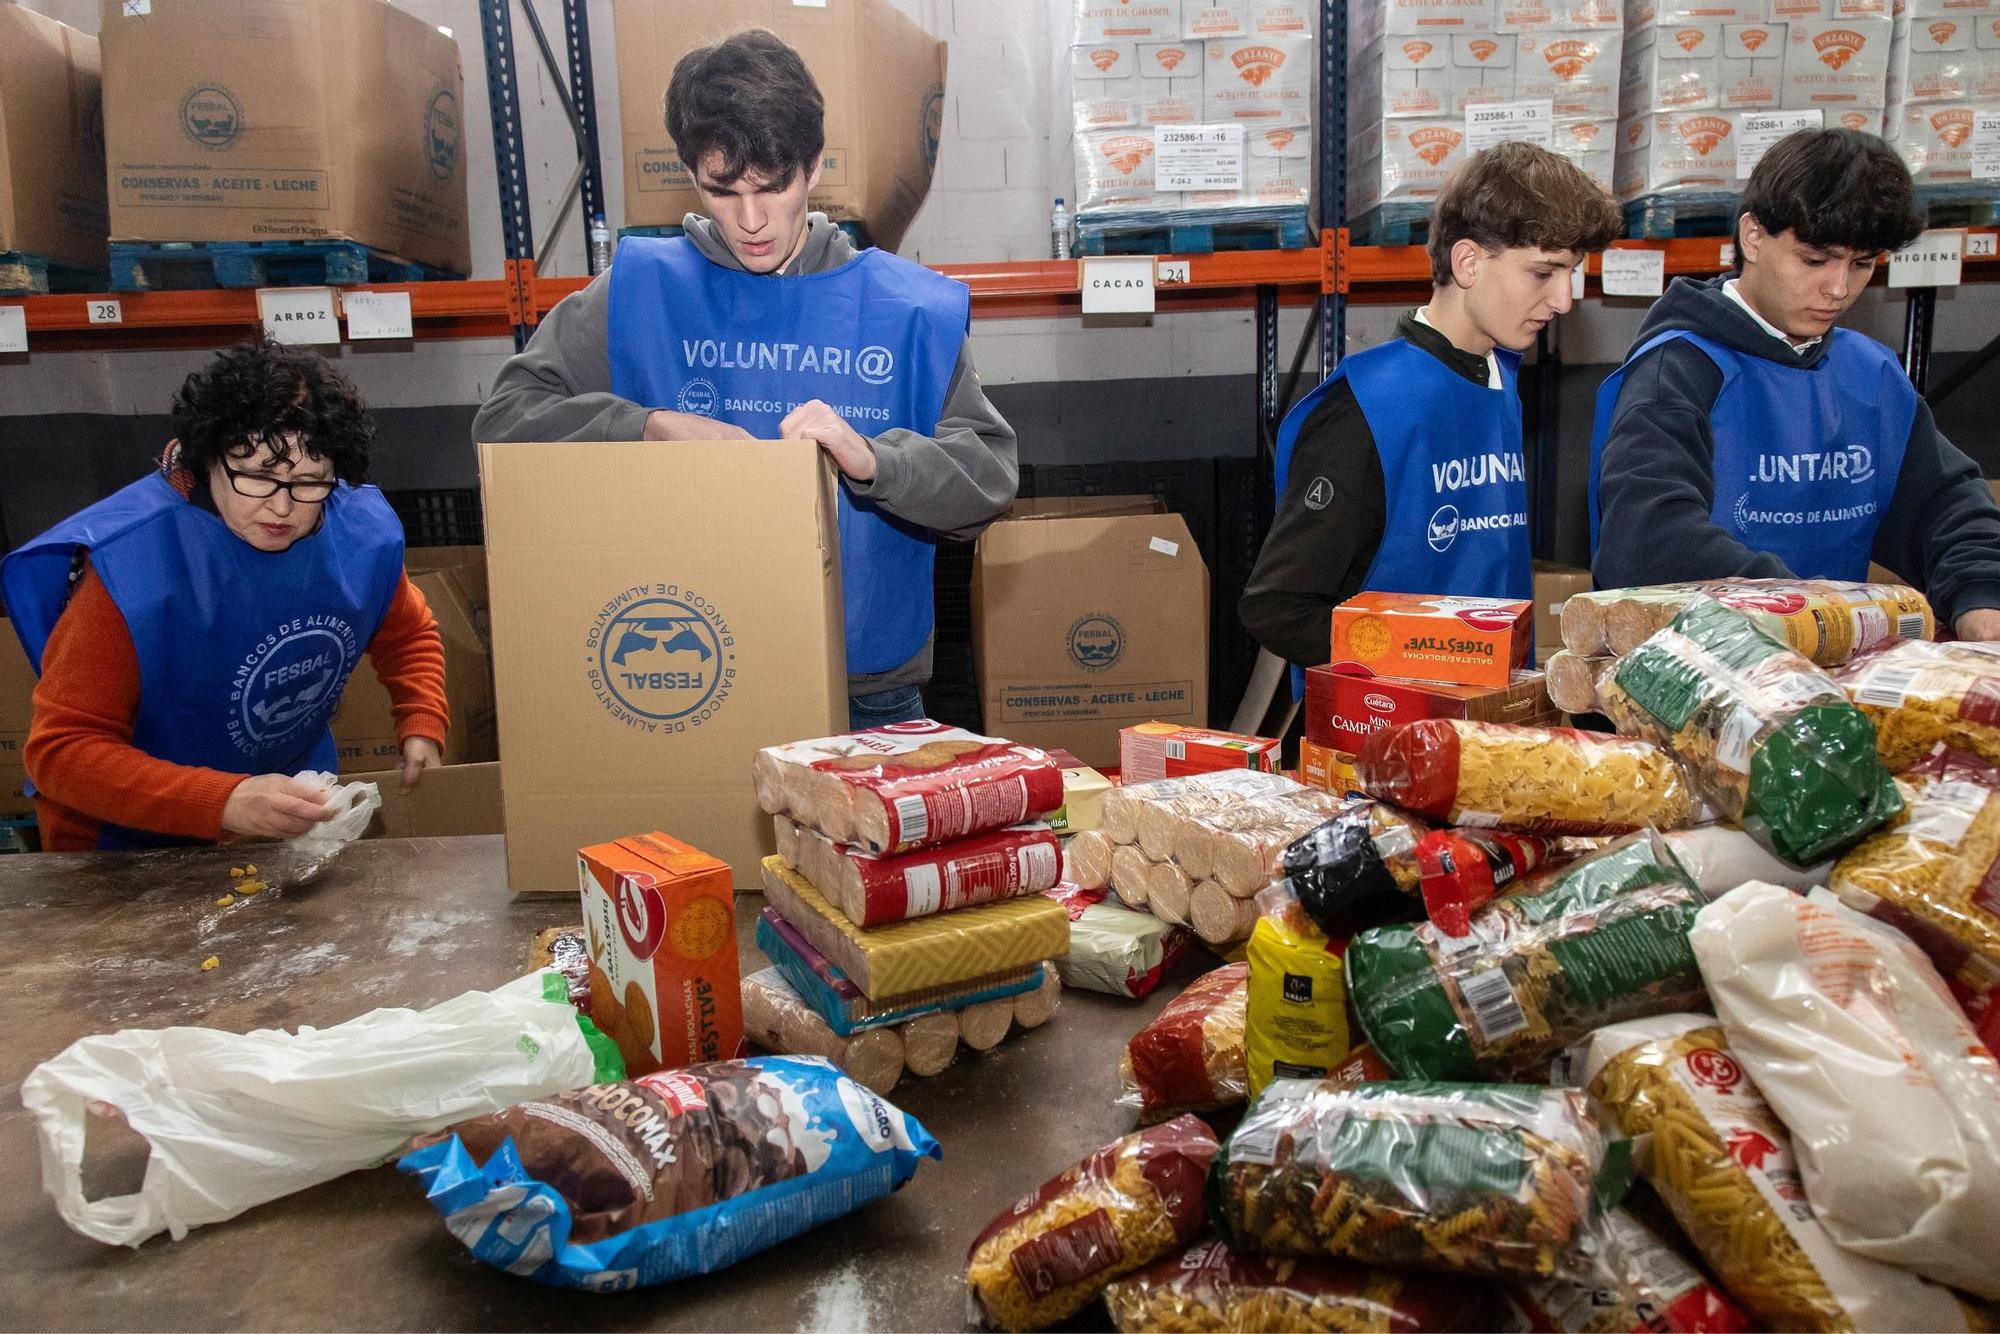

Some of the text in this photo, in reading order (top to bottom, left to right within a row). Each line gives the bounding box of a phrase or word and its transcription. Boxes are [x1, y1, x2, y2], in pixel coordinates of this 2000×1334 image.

[1817, 32, 1861, 47] URZANTE
[1236, 49, 1281, 63] URZANTE
[1474, 111, 1514, 122] 232586-1
[1163, 133, 1226, 142] 232586-1 -16
[121, 176, 318, 191] CONSERVAS ACEITE LECHE
[1973, 240, 1990, 253] 21
[1894, 252, 1958, 262] HIGIENE
[1167, 269, 1184, 281] 24
[1093, 279, 1144, 288] CACAO
[96, 305, 116, 319] 28
[274, 311, 326, 322] ARROZ
[683, 340, 894, 385] VOLUNTARI@
[724, 399, 782, 414] BANCOS
[832, 405, 890, 421] MENTOS
[1749, 445, 1875, 484] UNTAR
[1747, 510, 1803, 524] ANCOS
[1806, 511, 1821, 524] DE
[586, 583, 734, 649] BANCOS DE ALIMENTOS
[1409, 637, 1493, 656] DIGESTIVE
[231, 614, 357, 701] BANCOS DE ALIMENTOS
[1403, 652, 1493, 665] GALLETAS/BOLACHAS
[264, 649, 332, 689] FESBAL
[620, 672, 703, 689] FESBAL
[588, 668, 736, 734] BANCOS DE ALIMENTOS
[1006, 690, 1185, 708] CONSERVAS ACEITE LECHE
[1364, 697, 1395, 711] Cuétara
[1494, 863, 1515, 884] GALLO
